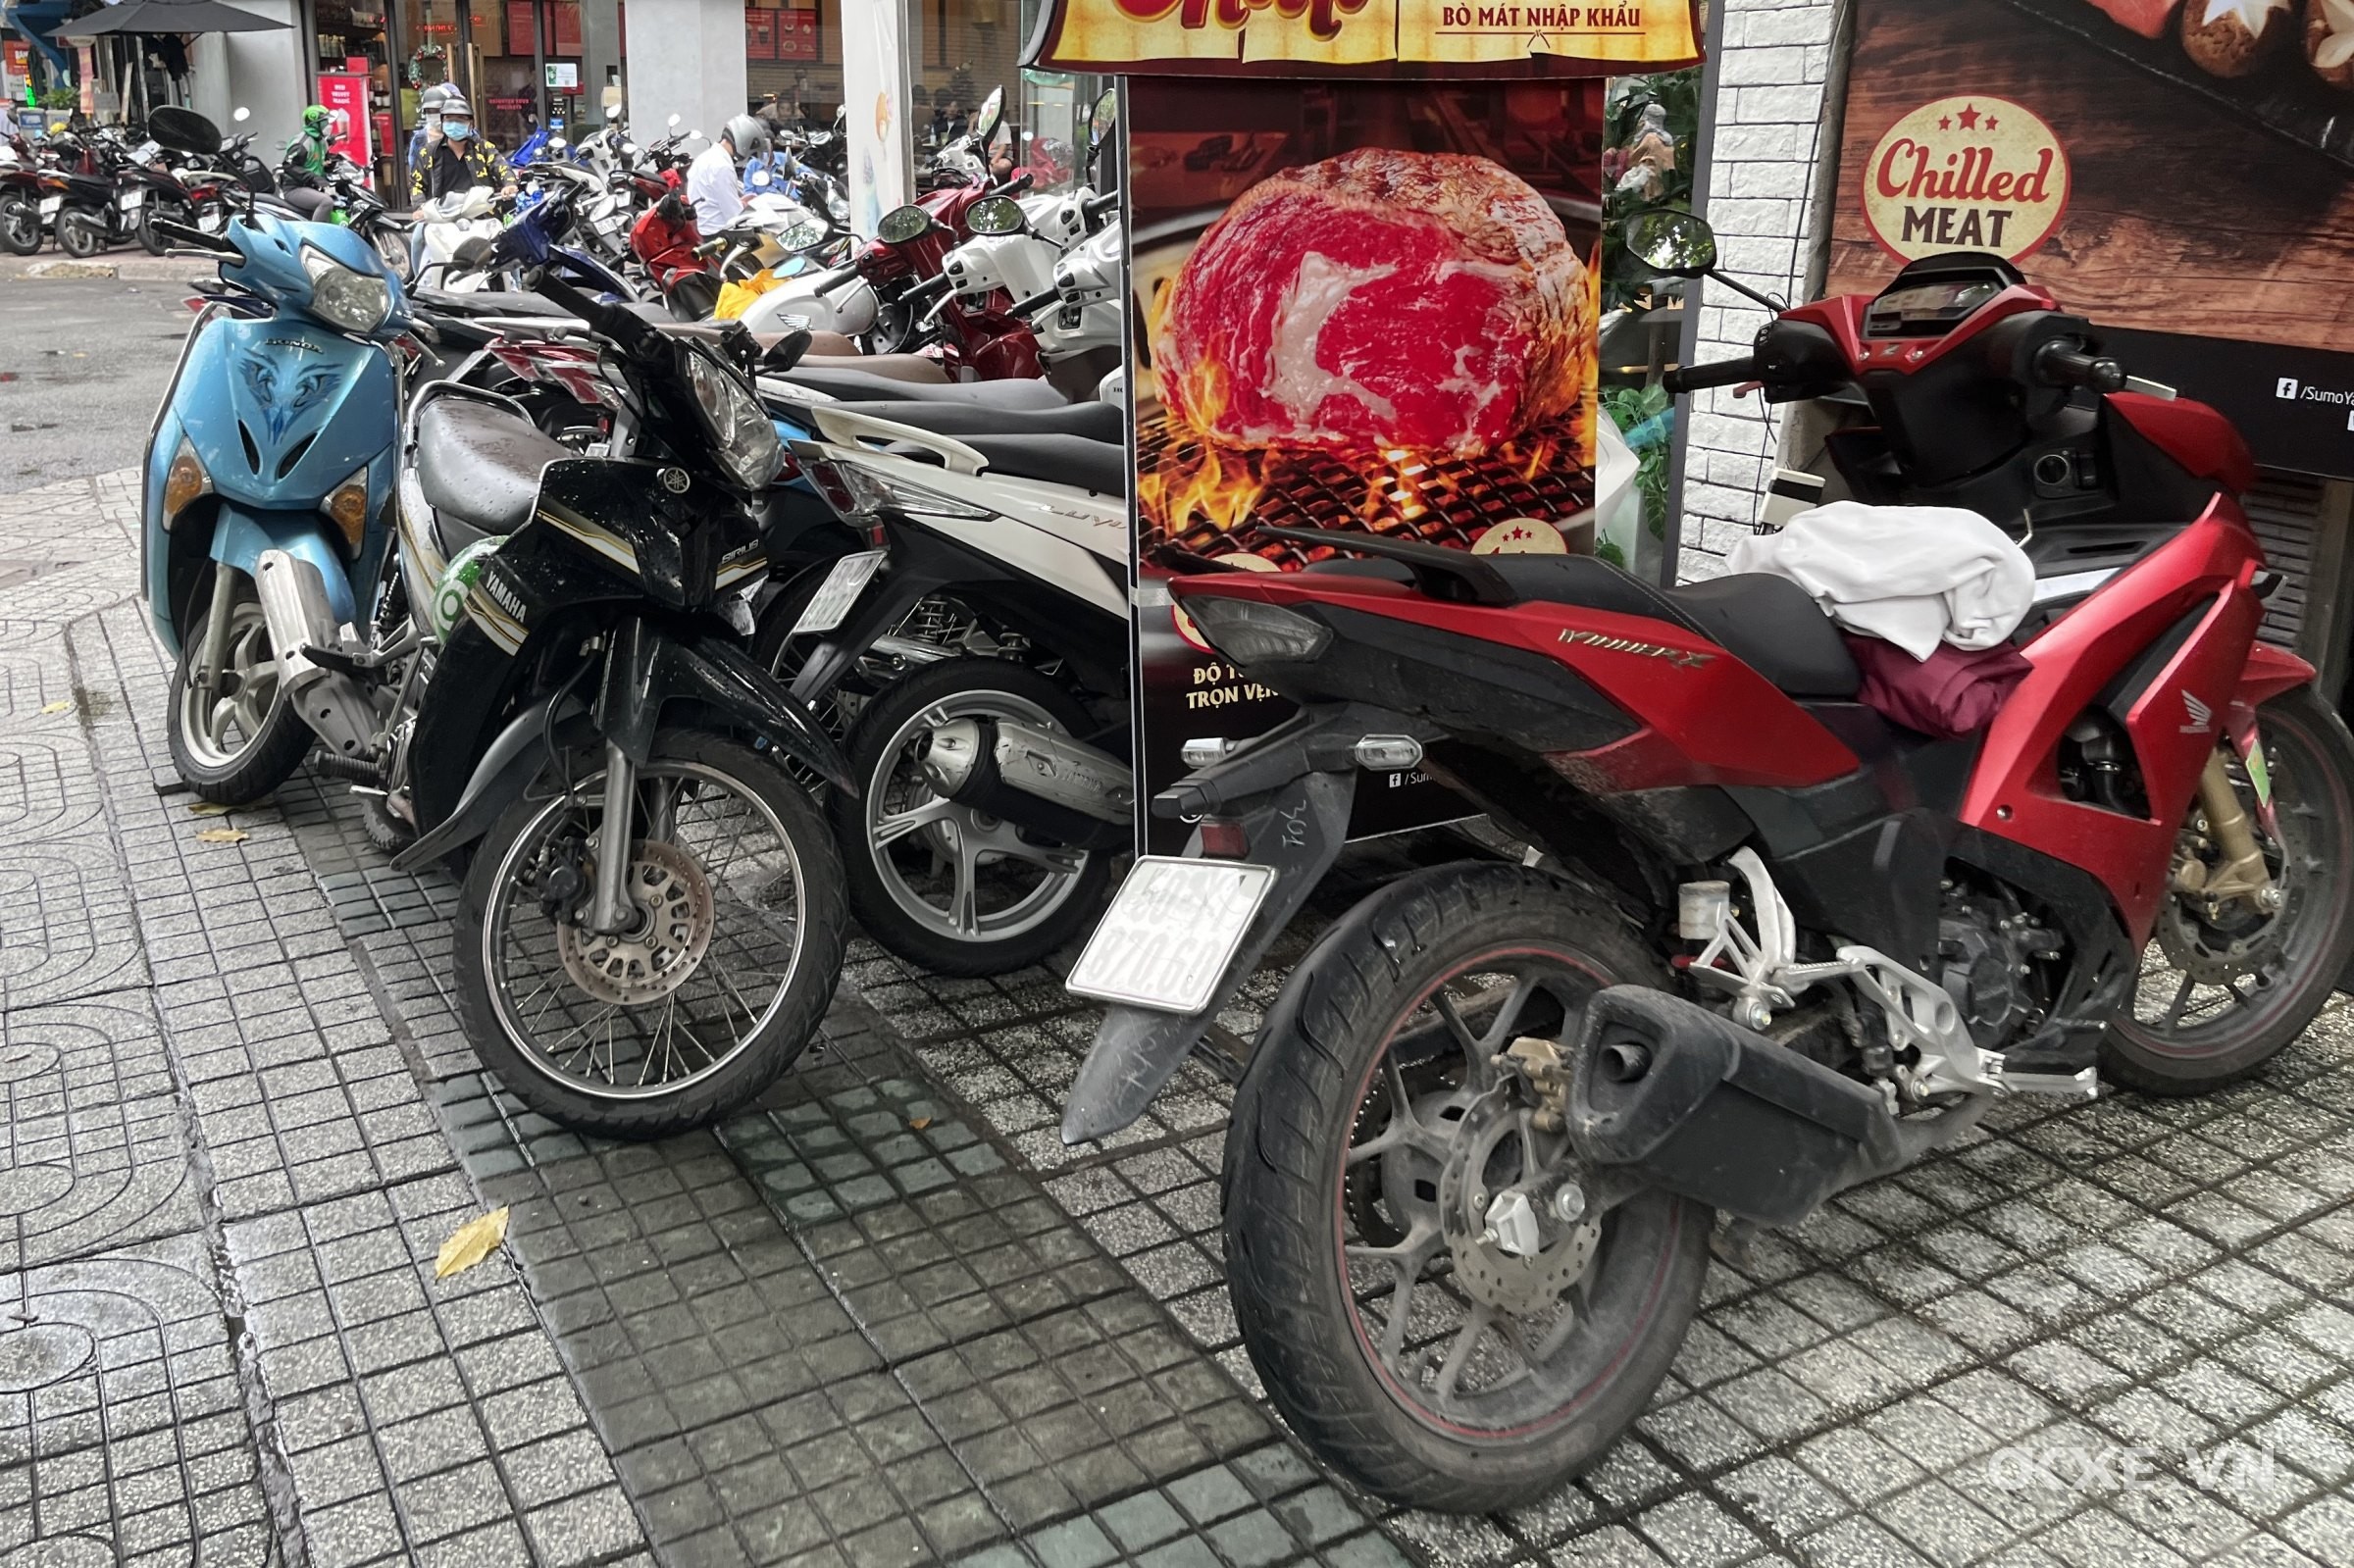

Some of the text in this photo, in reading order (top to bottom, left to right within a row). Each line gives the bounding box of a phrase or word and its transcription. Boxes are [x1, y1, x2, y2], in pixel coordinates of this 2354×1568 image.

[1443, 0, 1641, 30] BÒ MÁT NHẬP KHẨU
[1876, 138, 2054, 204] Chilled
[1901, 206, 2014, 248] MEAT
[721, 538, 759, 565] SIRIUS
[486, 570, 528, 624] YAMAHA
[1193, 662, 1222, 685] ĐỘ
[1186, 685, 1239, 709] TRỌN
